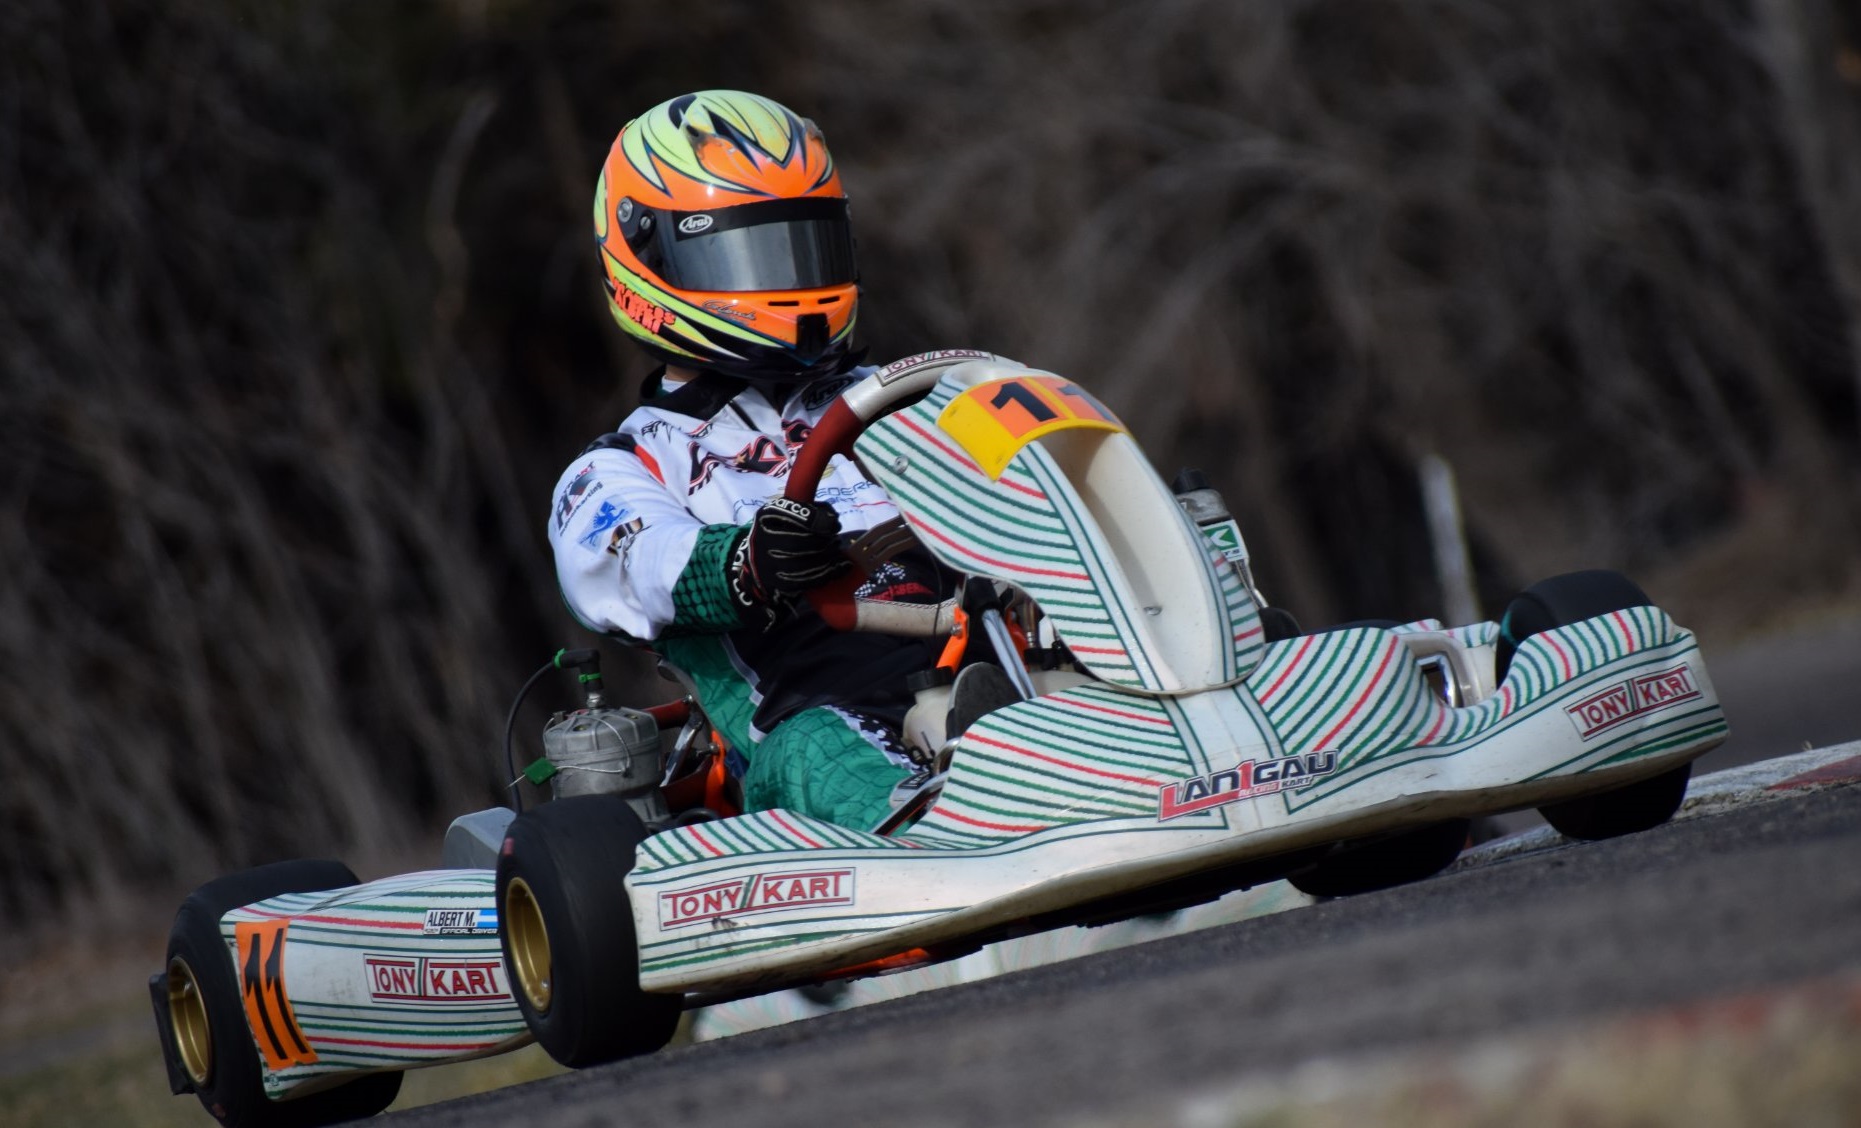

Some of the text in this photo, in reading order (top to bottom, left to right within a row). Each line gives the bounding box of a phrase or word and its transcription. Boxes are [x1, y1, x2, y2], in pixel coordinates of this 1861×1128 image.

[1569, 666, 1692, 728] TONY KART
[1282, 777, 1312, 787] KART
[662, 871, 852, 919] TONY KART
[428, 911, 476, 927] ALBERT M.
[244, 927, 308, 1060] 11
[366, 959, 501, 995] TONY KART
